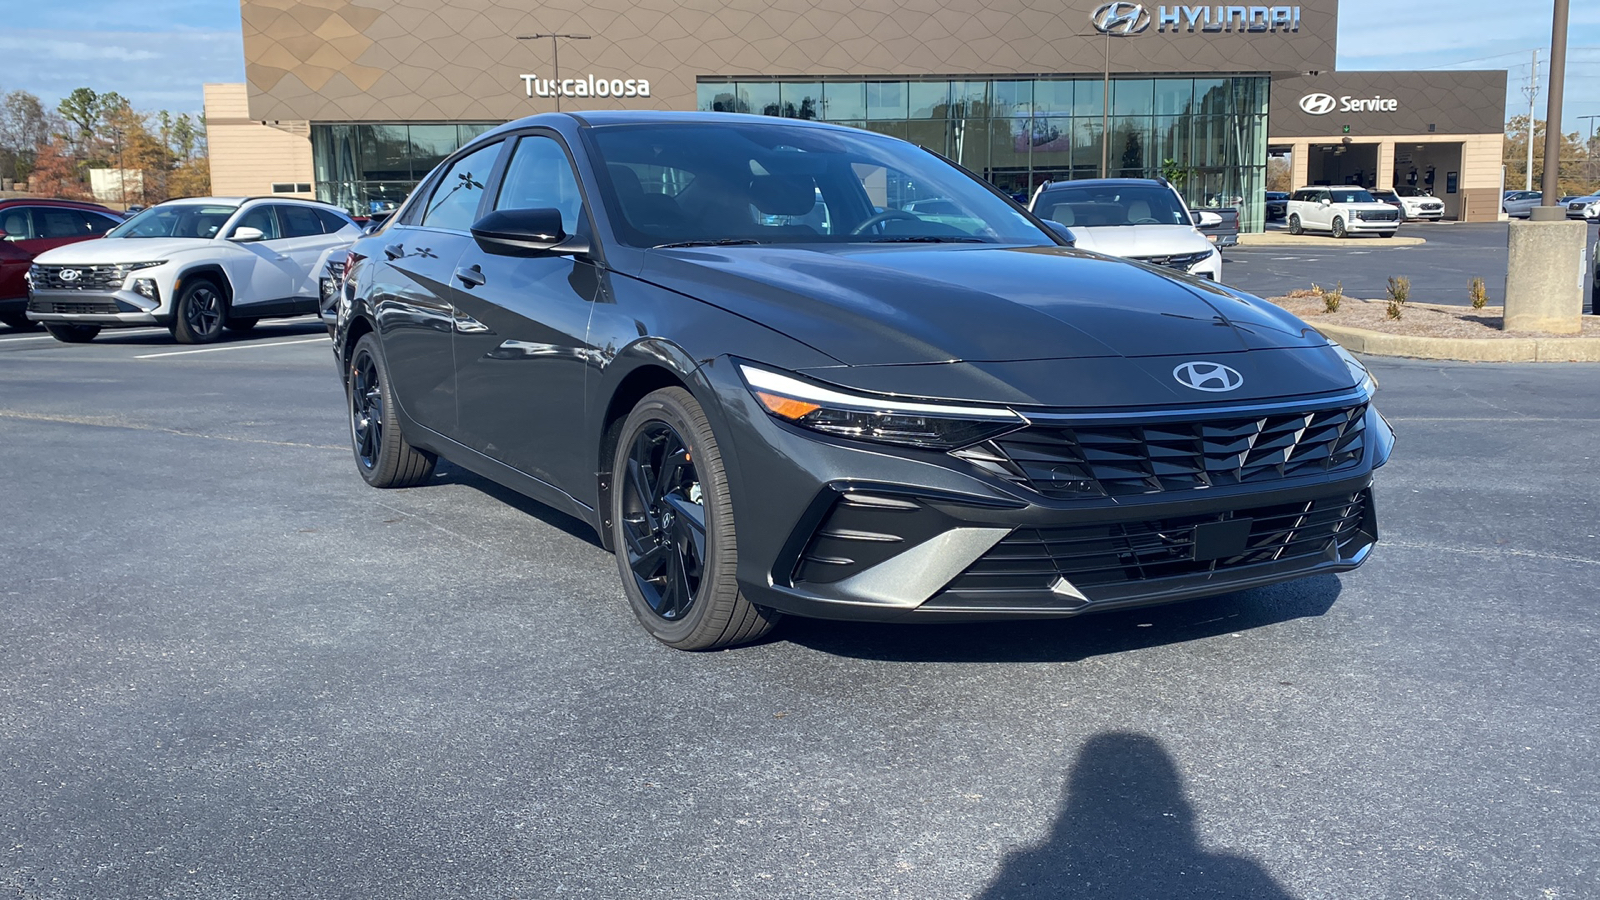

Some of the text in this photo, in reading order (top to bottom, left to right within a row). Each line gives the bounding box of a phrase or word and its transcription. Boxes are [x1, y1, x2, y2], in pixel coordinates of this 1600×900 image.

[1158, 5, 1300, 33] HYUNDAI
[519, 73, 650, 97] Tuscaloosa
[1340, 95, 1398, 113] Service
